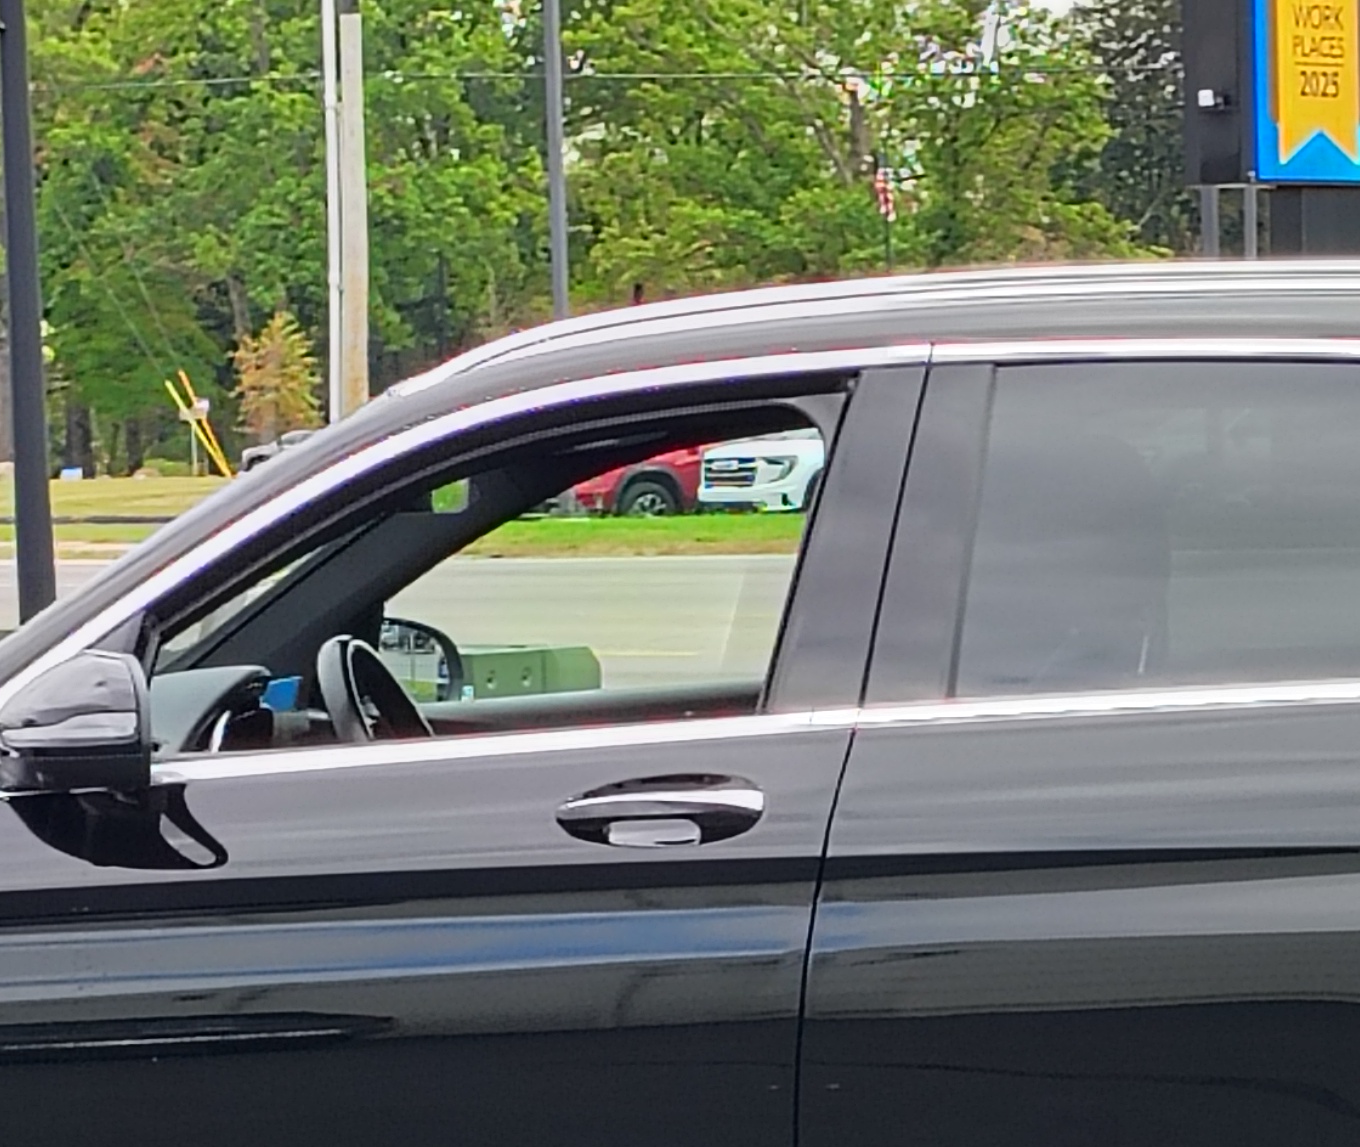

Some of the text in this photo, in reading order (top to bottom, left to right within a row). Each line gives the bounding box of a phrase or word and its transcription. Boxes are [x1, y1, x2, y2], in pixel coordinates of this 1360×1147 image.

[1292, 5, 1344, 30] WORK
[1292, 36, 1344, 58] PLACES
[1300, 71, 1339, 98] 2025
